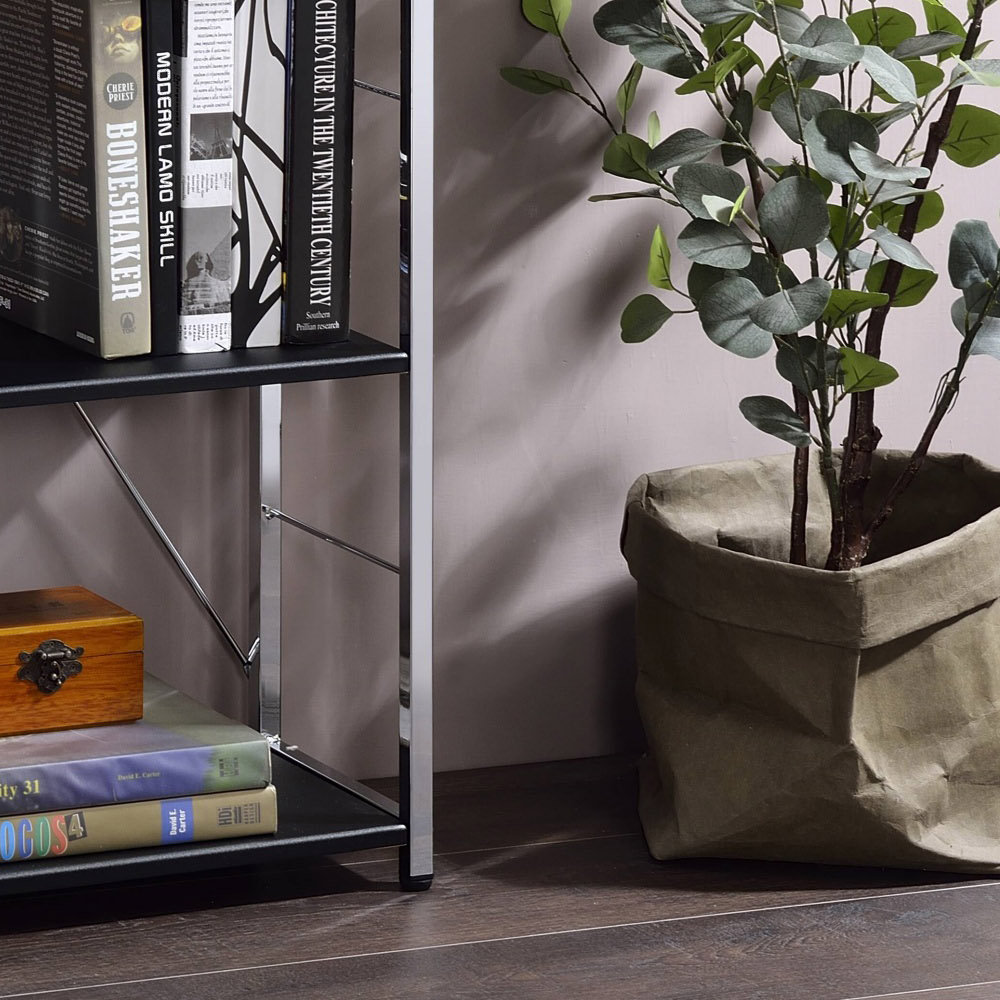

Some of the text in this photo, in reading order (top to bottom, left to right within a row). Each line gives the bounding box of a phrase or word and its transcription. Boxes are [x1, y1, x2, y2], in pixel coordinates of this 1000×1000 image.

[106, 82, 135, 94] CHERIE
[108, 91, 135, 103] PRIEST
[313, 97, 336, 113] IN
[312, 115, 335, 146] THE
[156, 51, 175, 268] MODERN LAMO SKILL
[311, 148, 334, 235] TWENTIETH
[106, 120, 143, 302] BONESHAKER
[310, 238, 333, 306] CENTURY
[306, 311, 331, 320] Southern
[317, 320, 340, 331] research
[117, 773, 135, 781] David
[142, 770, 160, 779] Carter
[23, 779, 41, 795] 31
[169, 817, 177, 836] David
[178, 809, 187, 833] Carter
